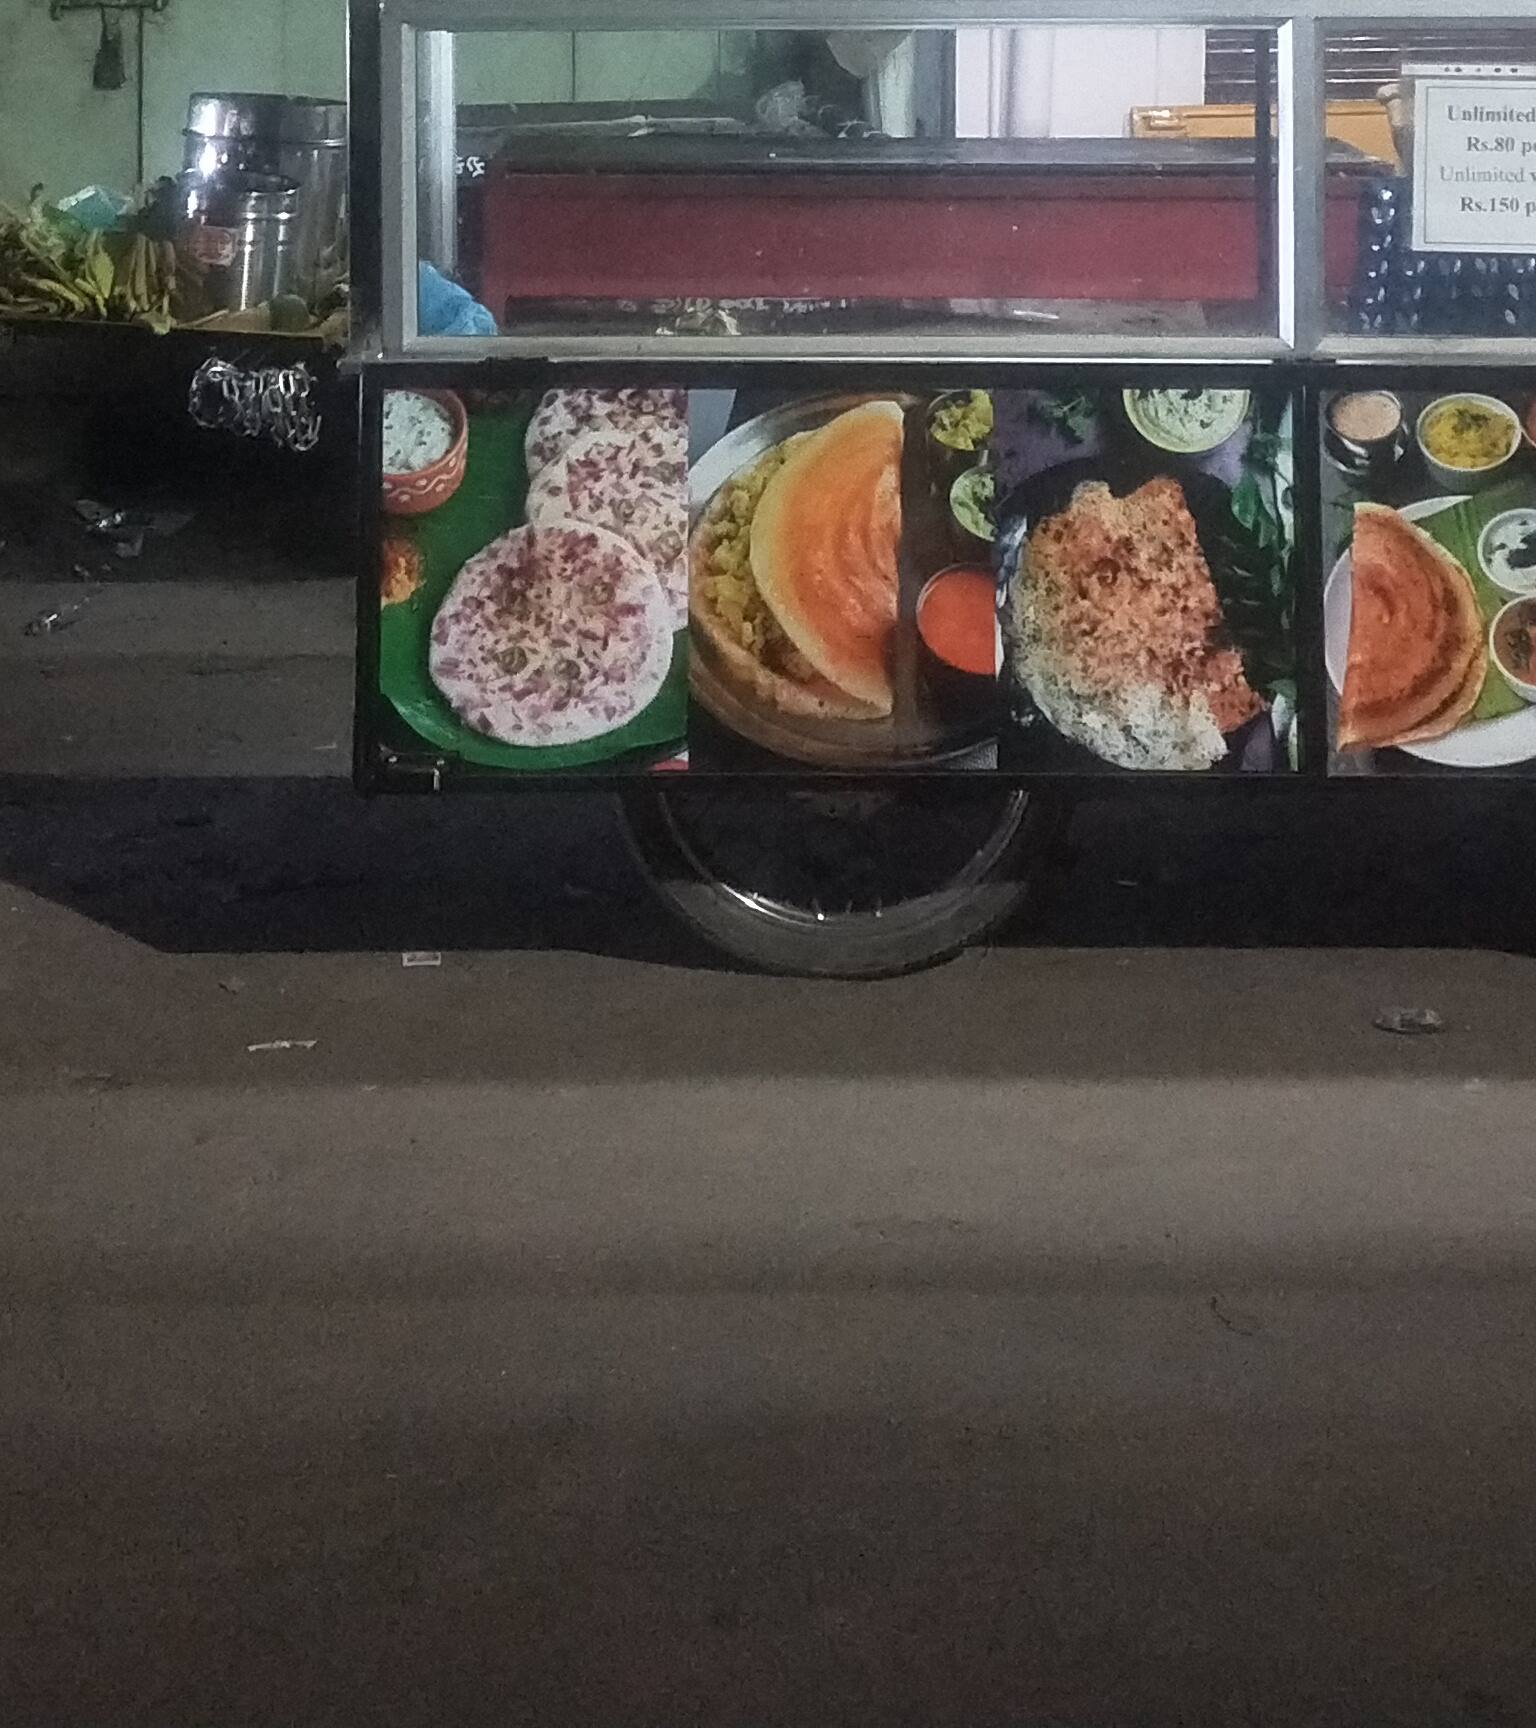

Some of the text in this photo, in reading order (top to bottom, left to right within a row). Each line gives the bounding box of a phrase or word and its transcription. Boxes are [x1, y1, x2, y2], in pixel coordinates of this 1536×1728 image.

[1447, 104, 1536, 124] Unlimited
[1466, 135, 1516, 153] Rs.80
[1439, 165, 1525, 184] Unlimited
[1460, 196, 1520, 214] Rs.150
